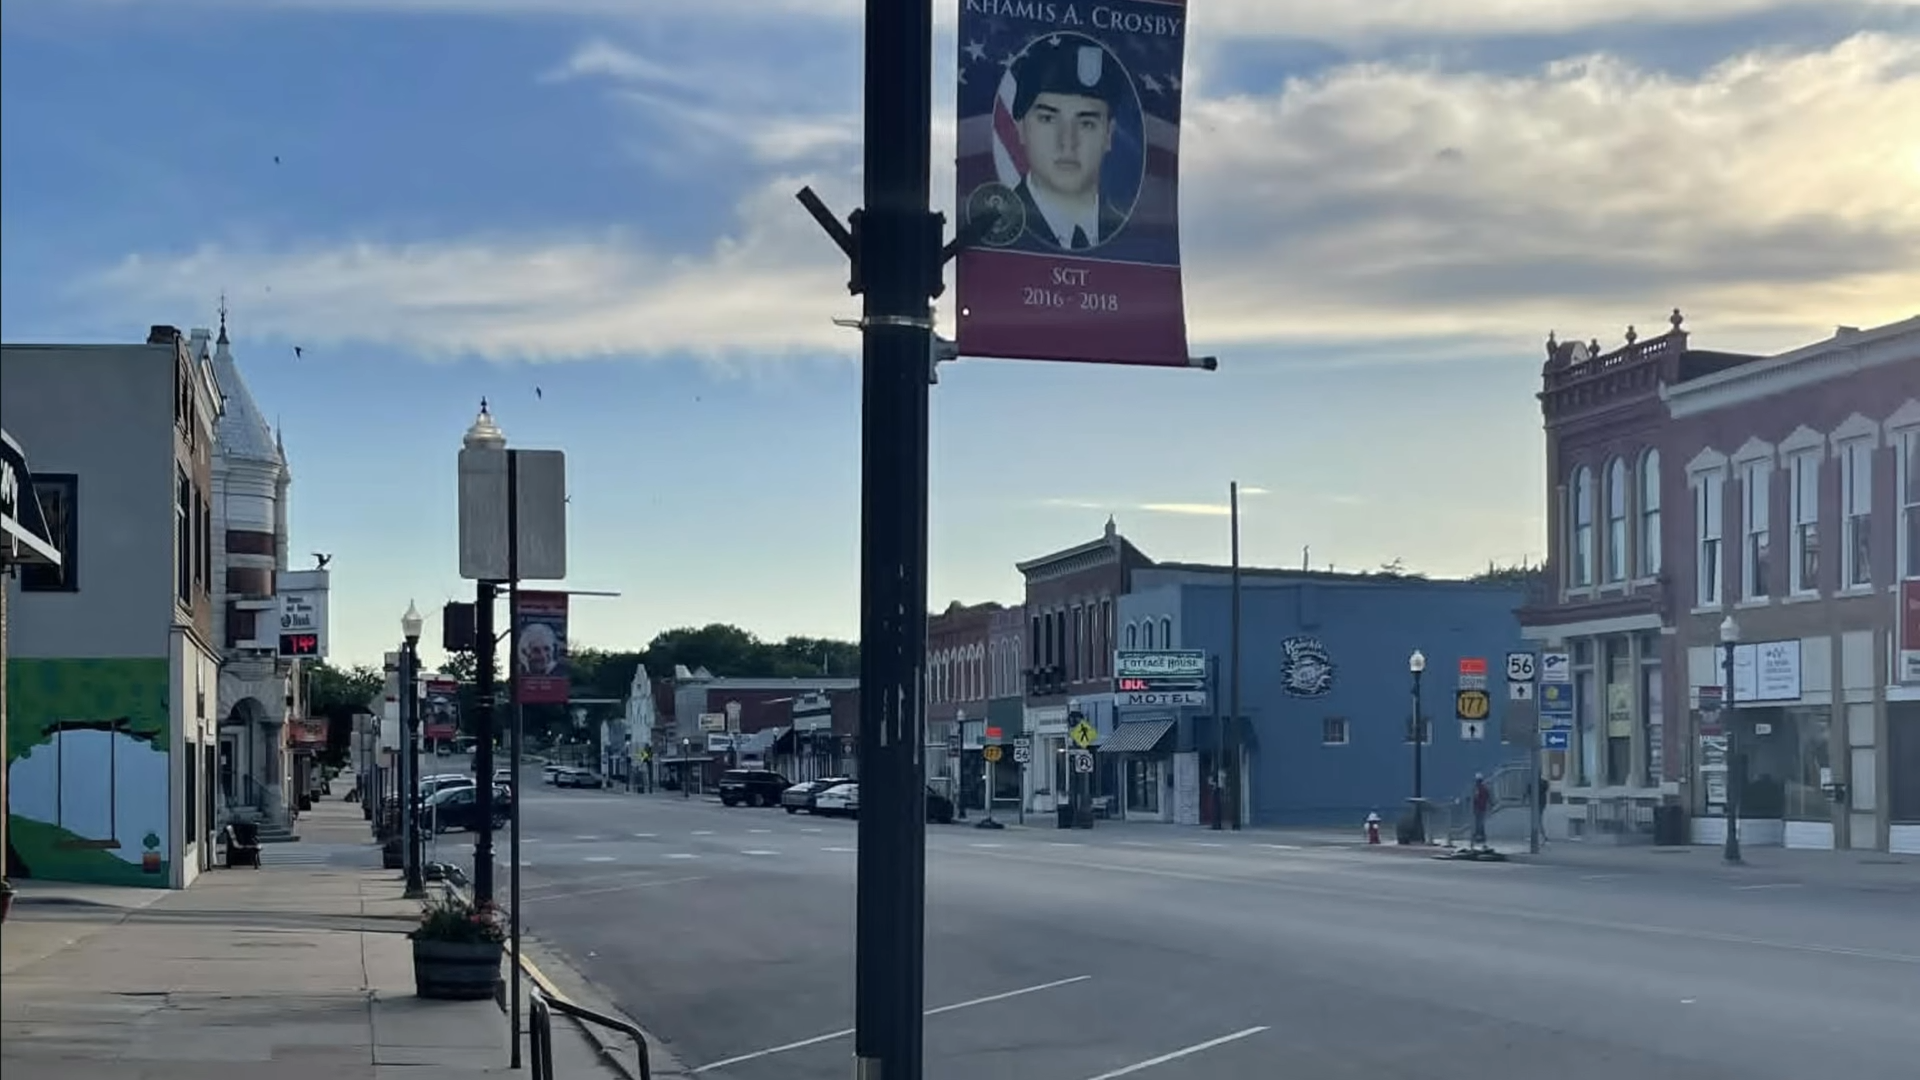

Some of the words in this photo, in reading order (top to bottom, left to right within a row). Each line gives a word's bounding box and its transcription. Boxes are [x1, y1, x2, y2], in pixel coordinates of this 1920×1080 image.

[964, 0, 1056, 22] KHAMIS
[1062, 3, 1084, 25] A.
[1092, 6, 1181, 36] CROSBY
[1052, 267, 1089, 286] SGT
[1023, 287, 1063, 307] 2016
[1079, 291, 1119, 311] 2018
[1167, 657, 1198, 669] HOUSE
[1511, 657, 1532, 674] 56
[1128, 693, 1194, 705] MOTEL
[1461, 696, 1484, 714] 177
[1016, 749, 1028, 759] 56
